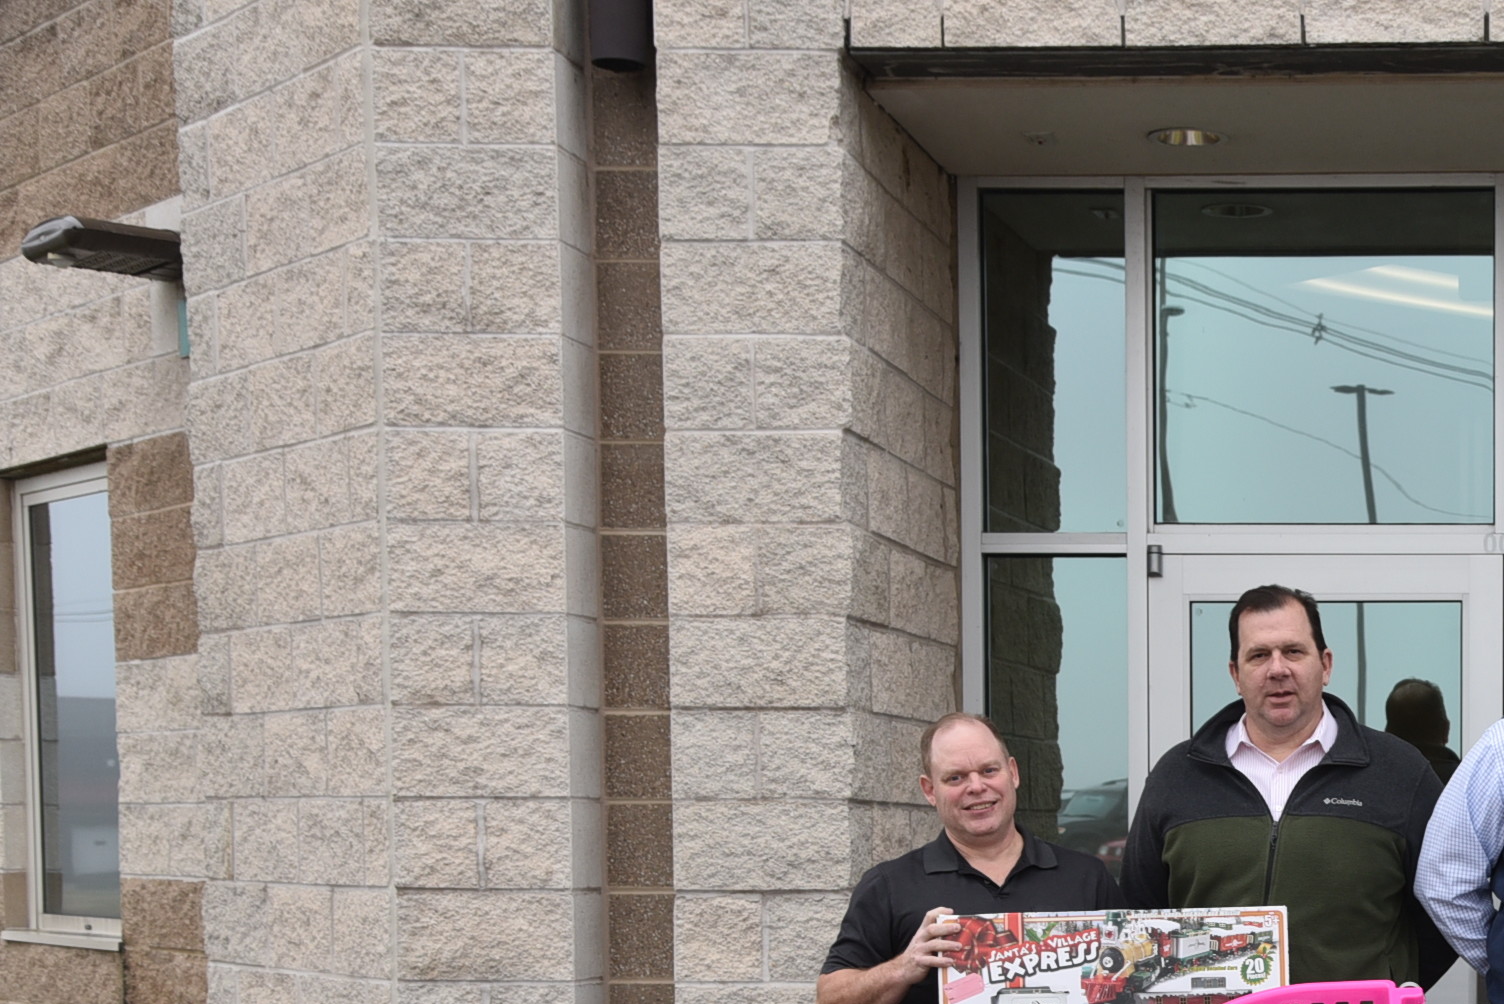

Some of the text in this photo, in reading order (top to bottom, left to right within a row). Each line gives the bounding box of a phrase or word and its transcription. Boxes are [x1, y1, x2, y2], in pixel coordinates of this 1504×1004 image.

[1331, 797, 1362, 807] Columbia
[1264, 914, 1279, 927] 5+
[988, 931, 1097, 962] SANTA'S VILLAGE
[988, 941, 1099, 983] EXPRESS
[1245, 957, 1265, 974] 20
